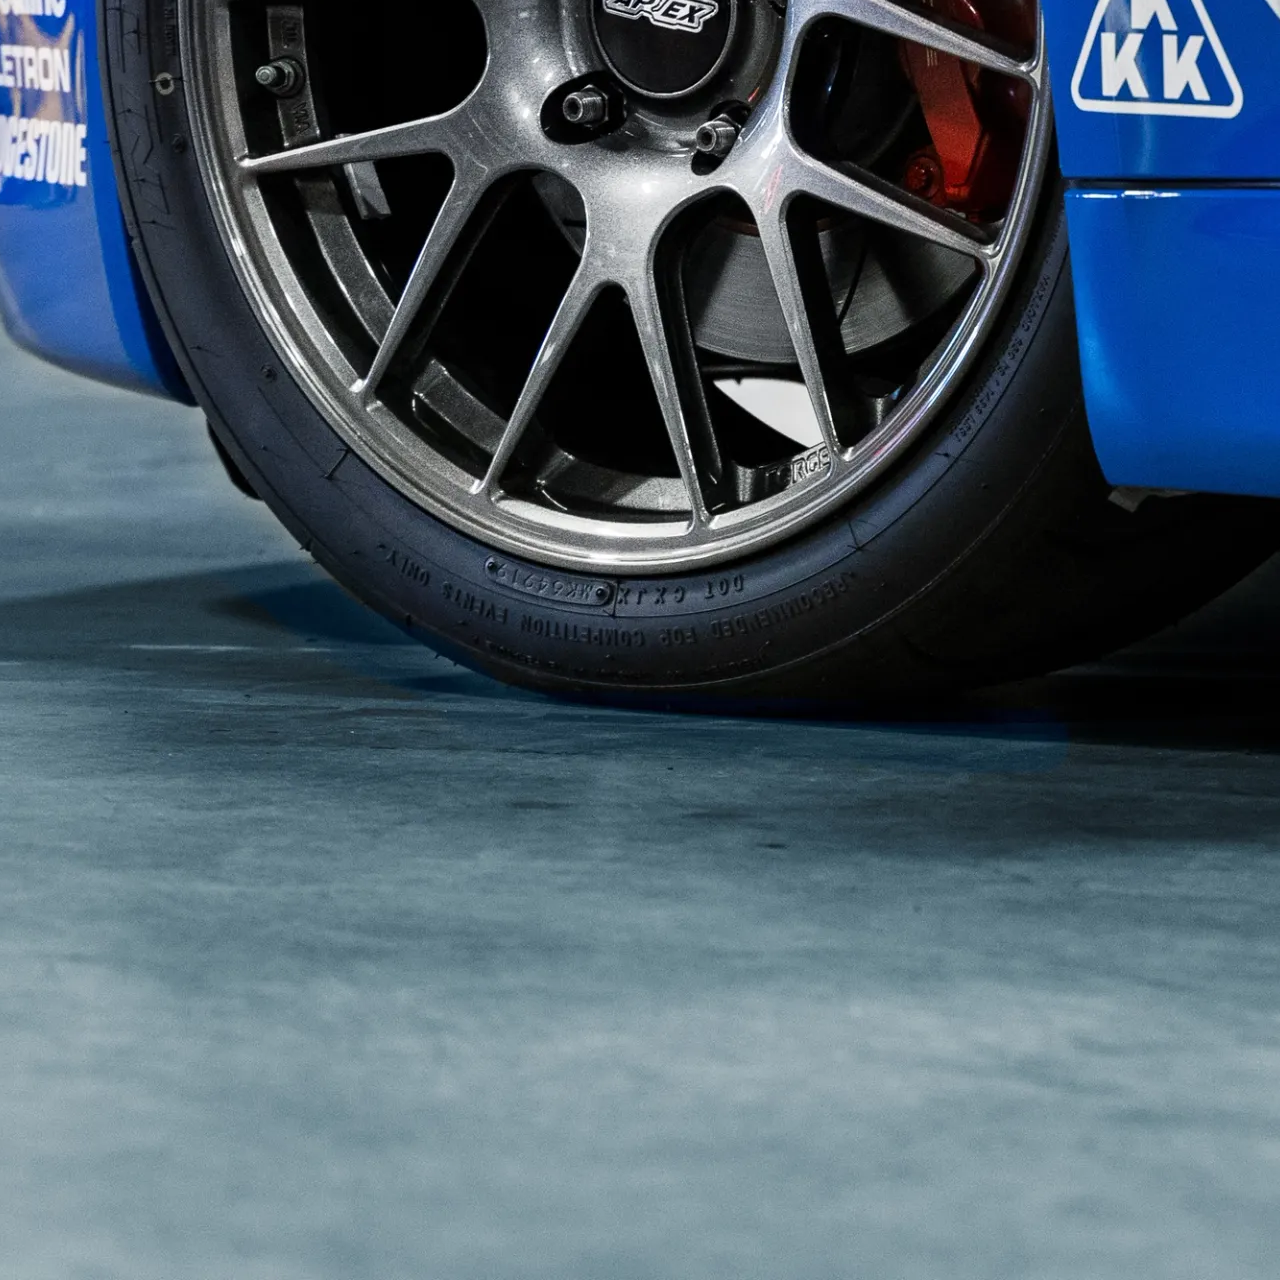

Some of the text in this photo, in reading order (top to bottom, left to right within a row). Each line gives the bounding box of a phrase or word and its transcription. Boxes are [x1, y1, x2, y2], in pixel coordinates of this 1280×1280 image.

[383, 545, 432, 589] ONLY
[519, 612, 646, 648] COMPETITION
[657, 623, 698, 649] FOR
